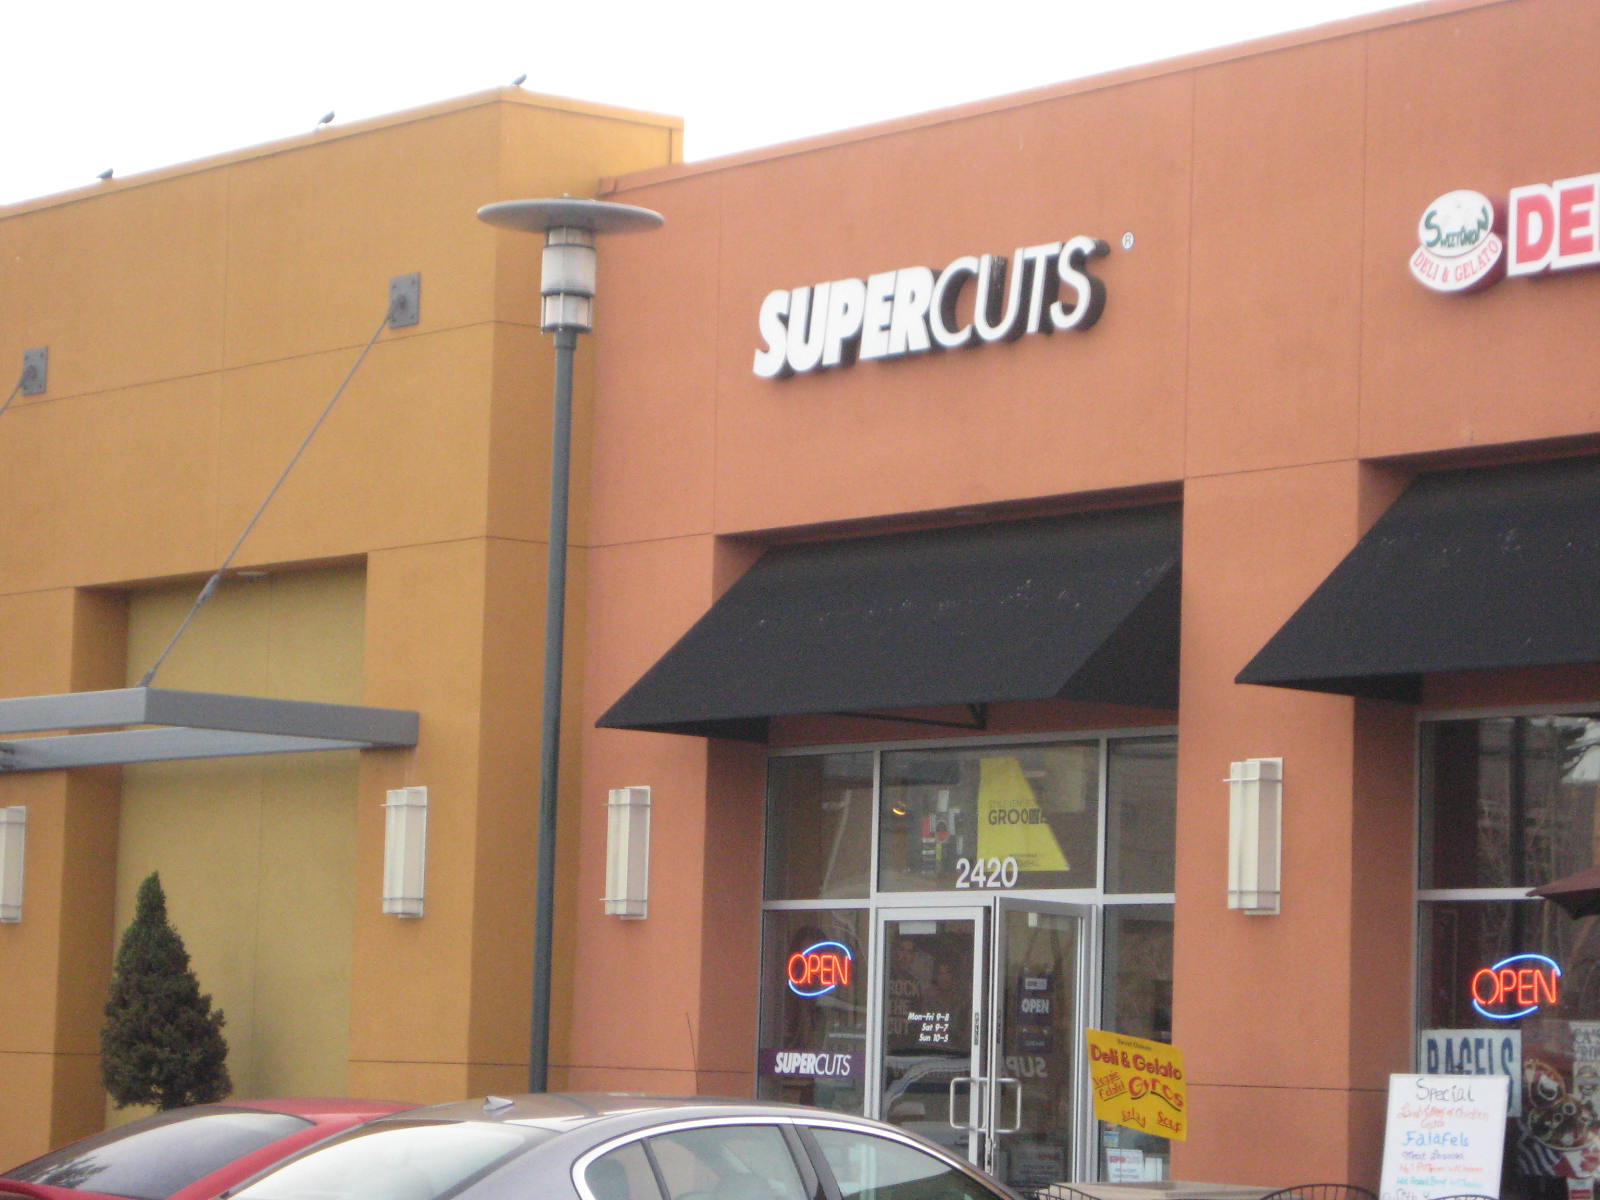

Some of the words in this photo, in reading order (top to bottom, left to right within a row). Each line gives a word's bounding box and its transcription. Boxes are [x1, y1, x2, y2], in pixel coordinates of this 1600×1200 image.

[1510, 181, 1600, 271] DE
[1413, 252, 1440, 281] DELI
[1455, 239, 1499, 282] GELATO
[753, 235, 1100, 380] SUPERCUTS
[955, 856, 1018, 888] 2420
[787, 952, 852, 986] OPEN
[1472, 968, 1558, 1005] OPEN
[1021, 998, 1050, 1014] OPEN
[919, 1033, 931, 1042] Sun
[922, 1023, 933, 1032] Sat
[775, 1052, 852, 1076] SUPERCUTS
[1090, 1044, 1119, 1066] Deli
[1121, 1051, 1130, 1068] &
[1132, 1054, 1182, 1080] Gelato
[1415, 1078, 1475, 1102] Special
[1401, 1130, 1470, 1147] Falafels
